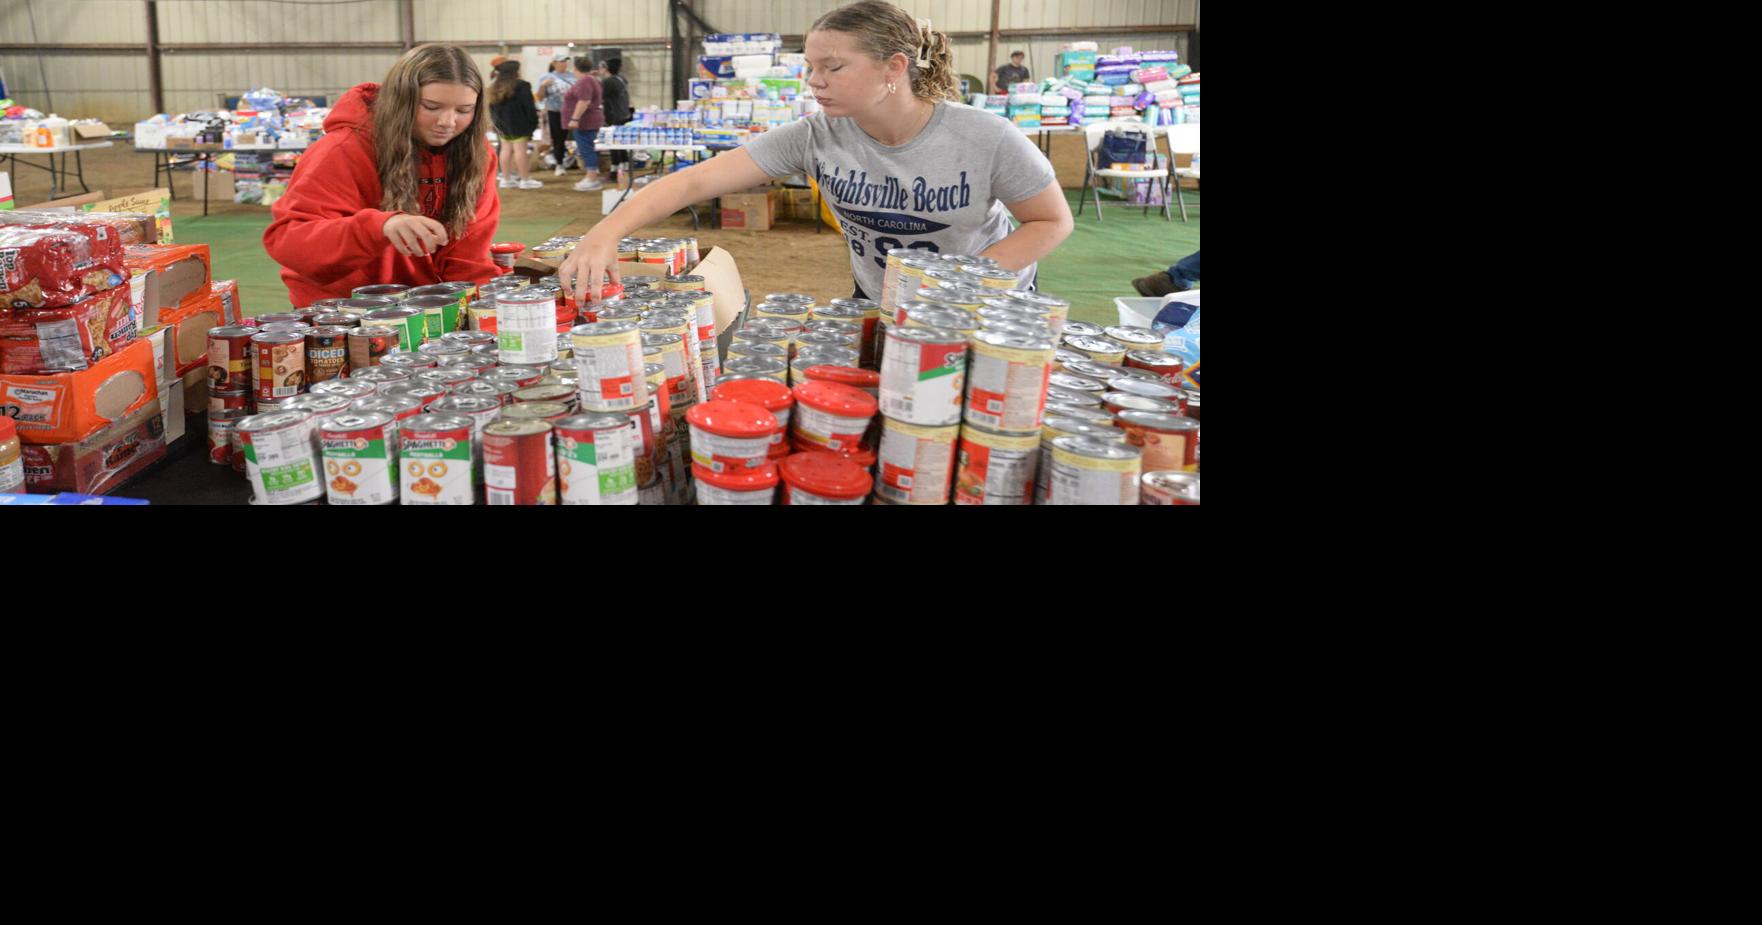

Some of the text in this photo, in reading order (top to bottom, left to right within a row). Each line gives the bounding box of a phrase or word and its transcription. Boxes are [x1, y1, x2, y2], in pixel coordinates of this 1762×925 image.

[816, 158, 970, 213] Wrightsville Beach
[109, 196, 150, 212] Apple Sauce
[844, 211, 927, 231] NORTH CAROLINA
[840, 220, 871, 243] EST.
[6, 249, 16, 270] Top
[309, 348, 345, 359] DICED
[21, 388, 48, 396] Maruchan
